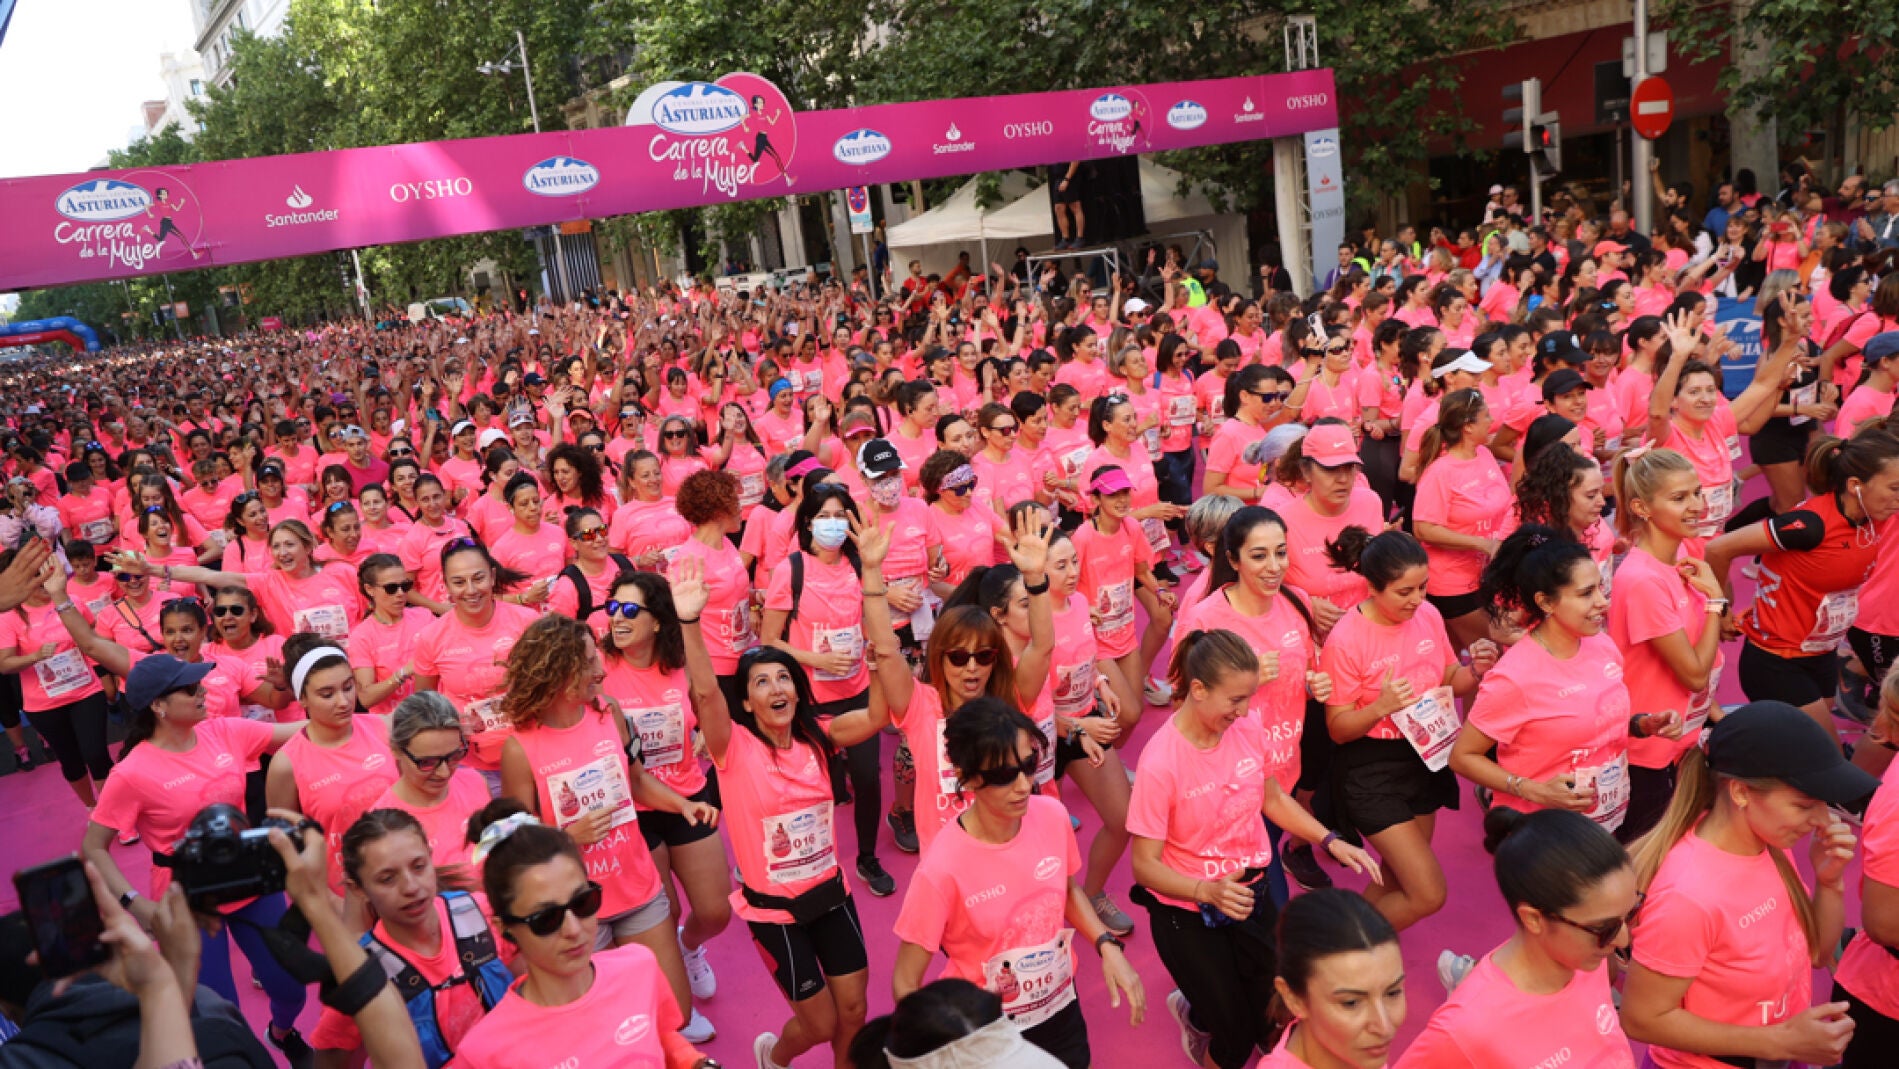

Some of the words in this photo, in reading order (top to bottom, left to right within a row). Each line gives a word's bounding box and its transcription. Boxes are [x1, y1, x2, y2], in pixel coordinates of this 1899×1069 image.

[1286, 92, 1328, 110] OYSHO
[660, 103, 742, 123] ASTURIANA
[1003, 120, 1054, 139] OYSHO
[648, 133, 731, 162] Carrera
[932, 141, 976, 155] Santander
[530, 173, 595, 189] ASTURIANA
[673, 162, 689, 181] de
[691, 160, 703, 179] la
[702, 152, 761, 198] Mujer
[389, 177, 473, 203] OYSHO
[66, 196, 145, 214] ASTURIANA
[264, 209, 339, 228] Santander
[53, 221, 135, 244] Carrera
[79, 241, 95, 258] de
[97, 241, 109, 256] la
[109, 234, 166, 270] Mujer
[965, 883, 1007, 909] OYSHO
[1738, 896, 1778, 929] OYSHO
[1022, 972, 1054, 993] 016
[1757, 993, 1788, 1026] TU
